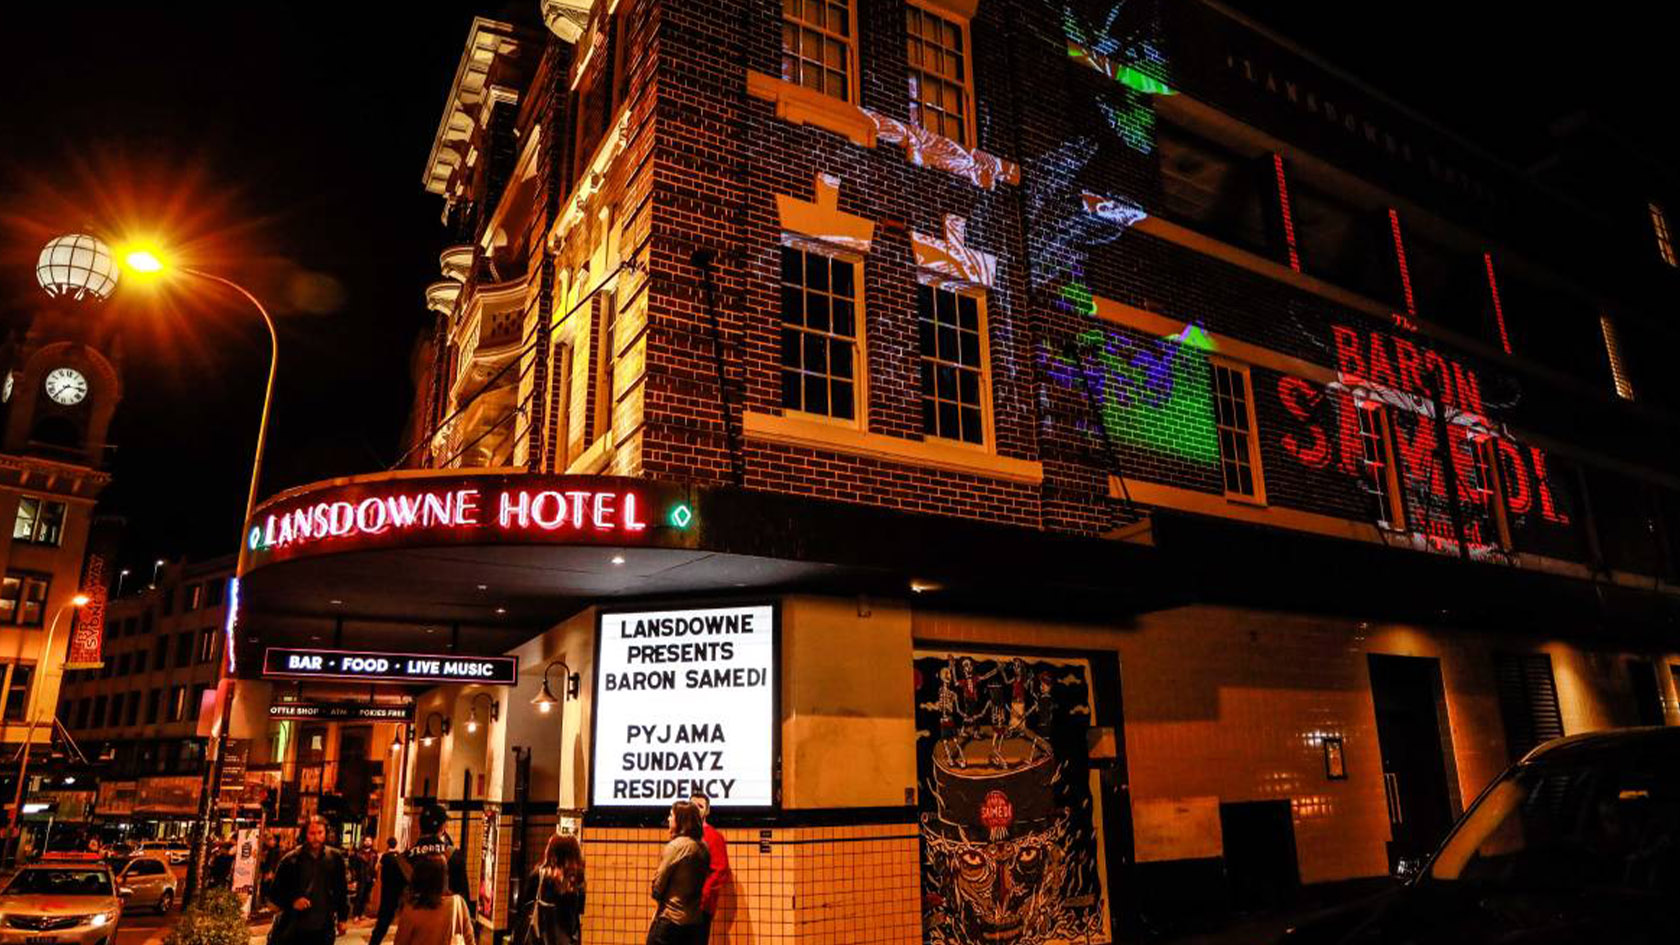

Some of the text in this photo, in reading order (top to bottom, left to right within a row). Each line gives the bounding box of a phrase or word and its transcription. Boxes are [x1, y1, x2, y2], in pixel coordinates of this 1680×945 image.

[1331, 324, 1486, 420] BARON
[264, 489, 646, 546] LANSDOWNE HOTEL
[620, 614, 754, 638] LANSDOWNE
[627, 641, 734, 664] PRESENTS
[289, 655, 494, 676] BAR FOOD LIVE MUSIC
[605, 667, 767, 691] BARON SAMEDI
[296, 707, 319, 716] SHOP
[627, 723, 726, 744] PYJAMA
[622, 751, 723, 771] SUNDAYZ
[613, 779, 736, 799] RESIDENCY
